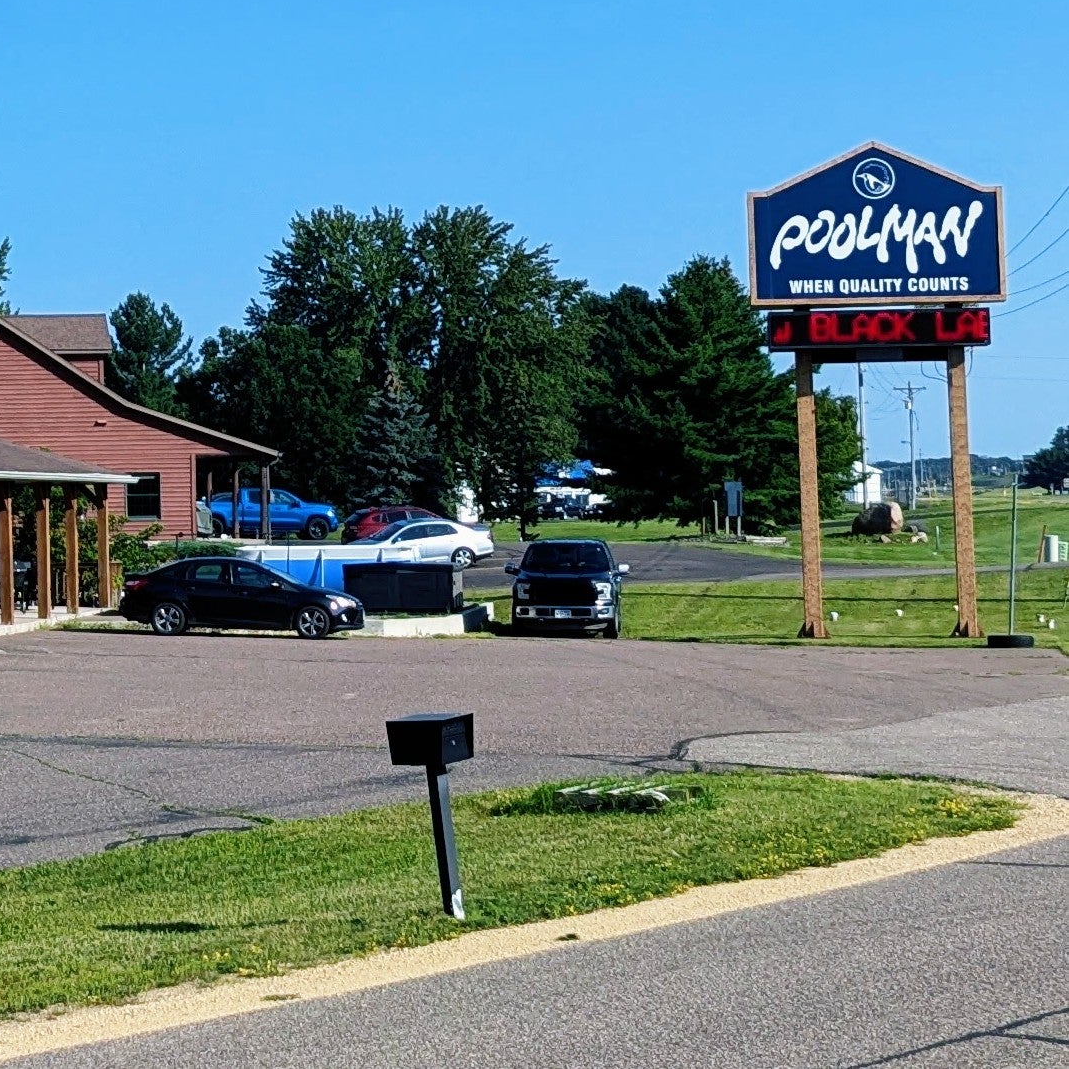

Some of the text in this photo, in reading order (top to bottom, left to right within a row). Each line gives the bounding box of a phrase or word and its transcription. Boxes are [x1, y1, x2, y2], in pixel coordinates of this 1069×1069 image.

[769, 201, 982, 273] POOLMAN
[789, 277, 969, 294] WHEN QUALITY COUNTS
